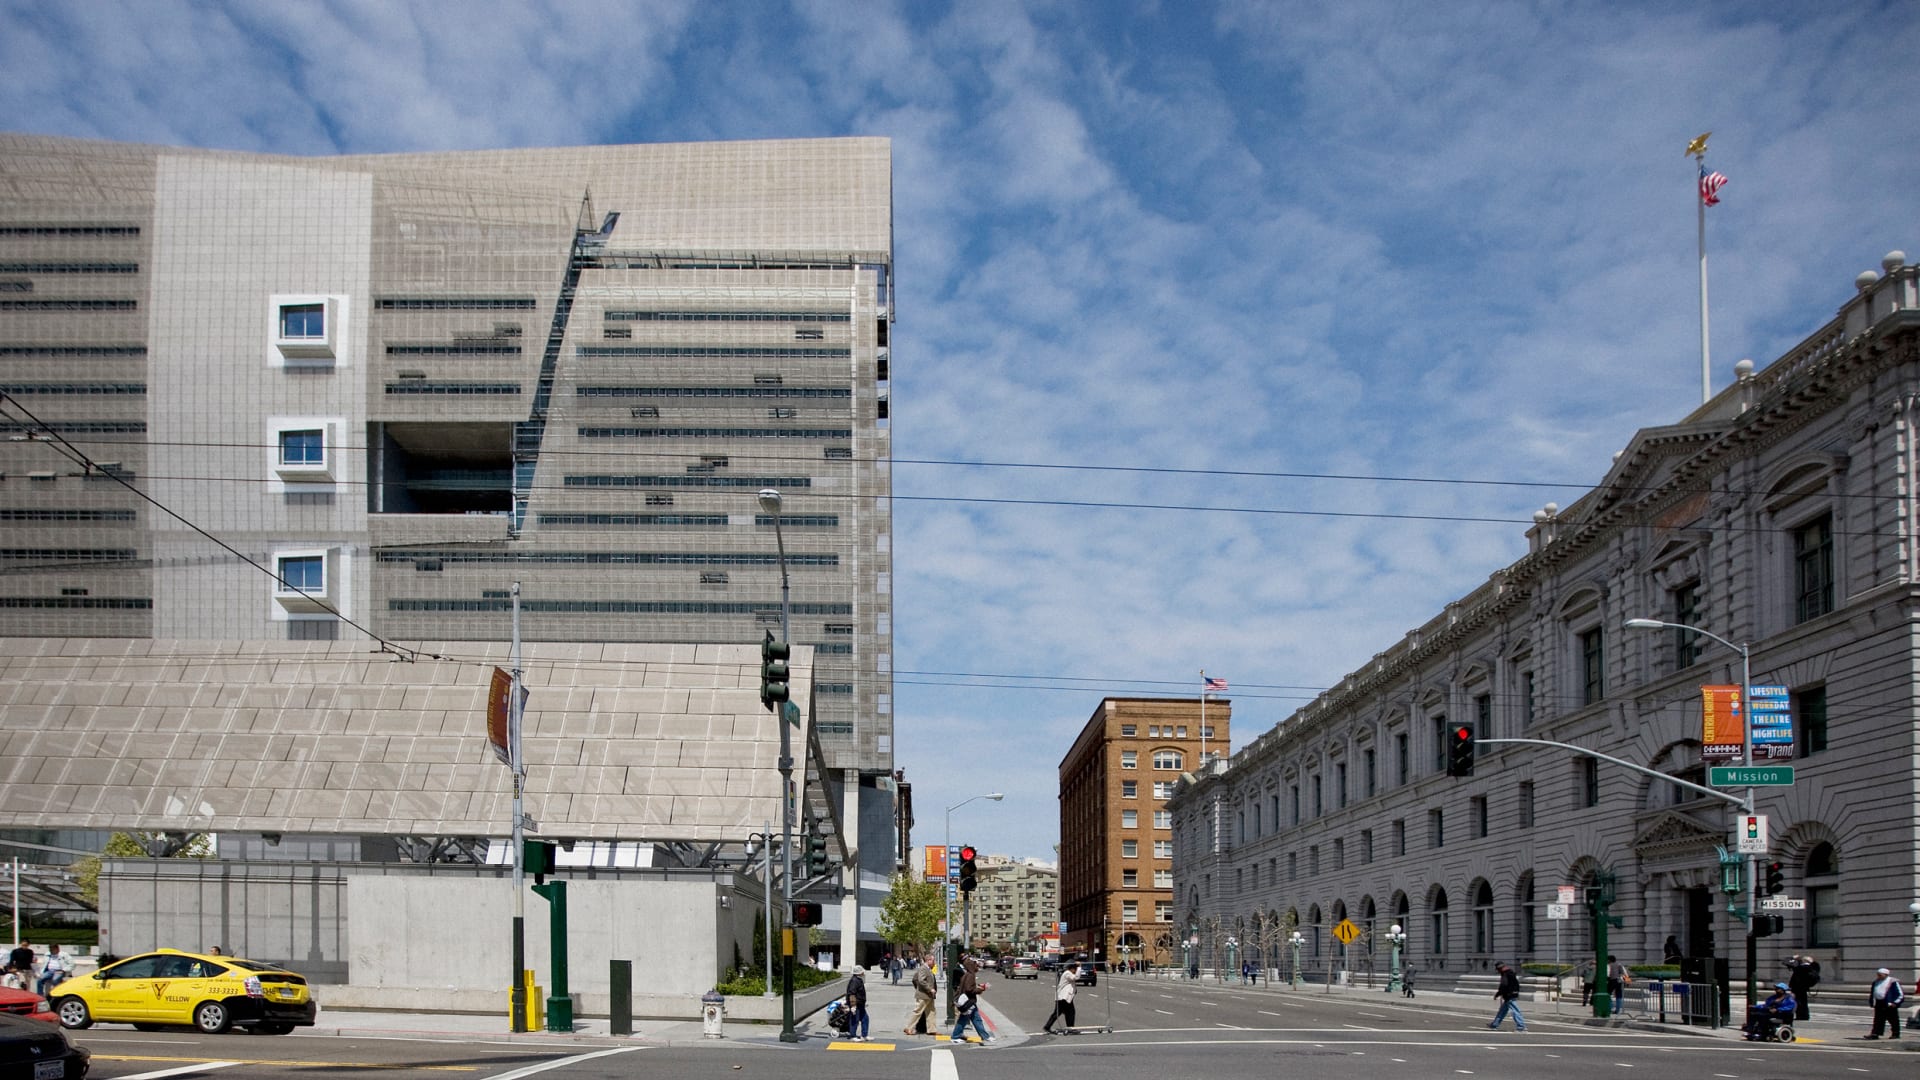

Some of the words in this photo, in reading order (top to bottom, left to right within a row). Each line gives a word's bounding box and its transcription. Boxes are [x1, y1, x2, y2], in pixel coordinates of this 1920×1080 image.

[1750, 687, 1787, 696] LIFESTYLE
[1752, 701, 1789, 710] WORKDAY
[1753, 715, 1790, 724] THEATRE
[1704, 714, 1714, 742] CENTRAL
[1752, 729, 1792, 738] NIGHTLIFE
[1727, 772, 1777, 781] Mission
[208, 987, 239, 995] 333-3333
